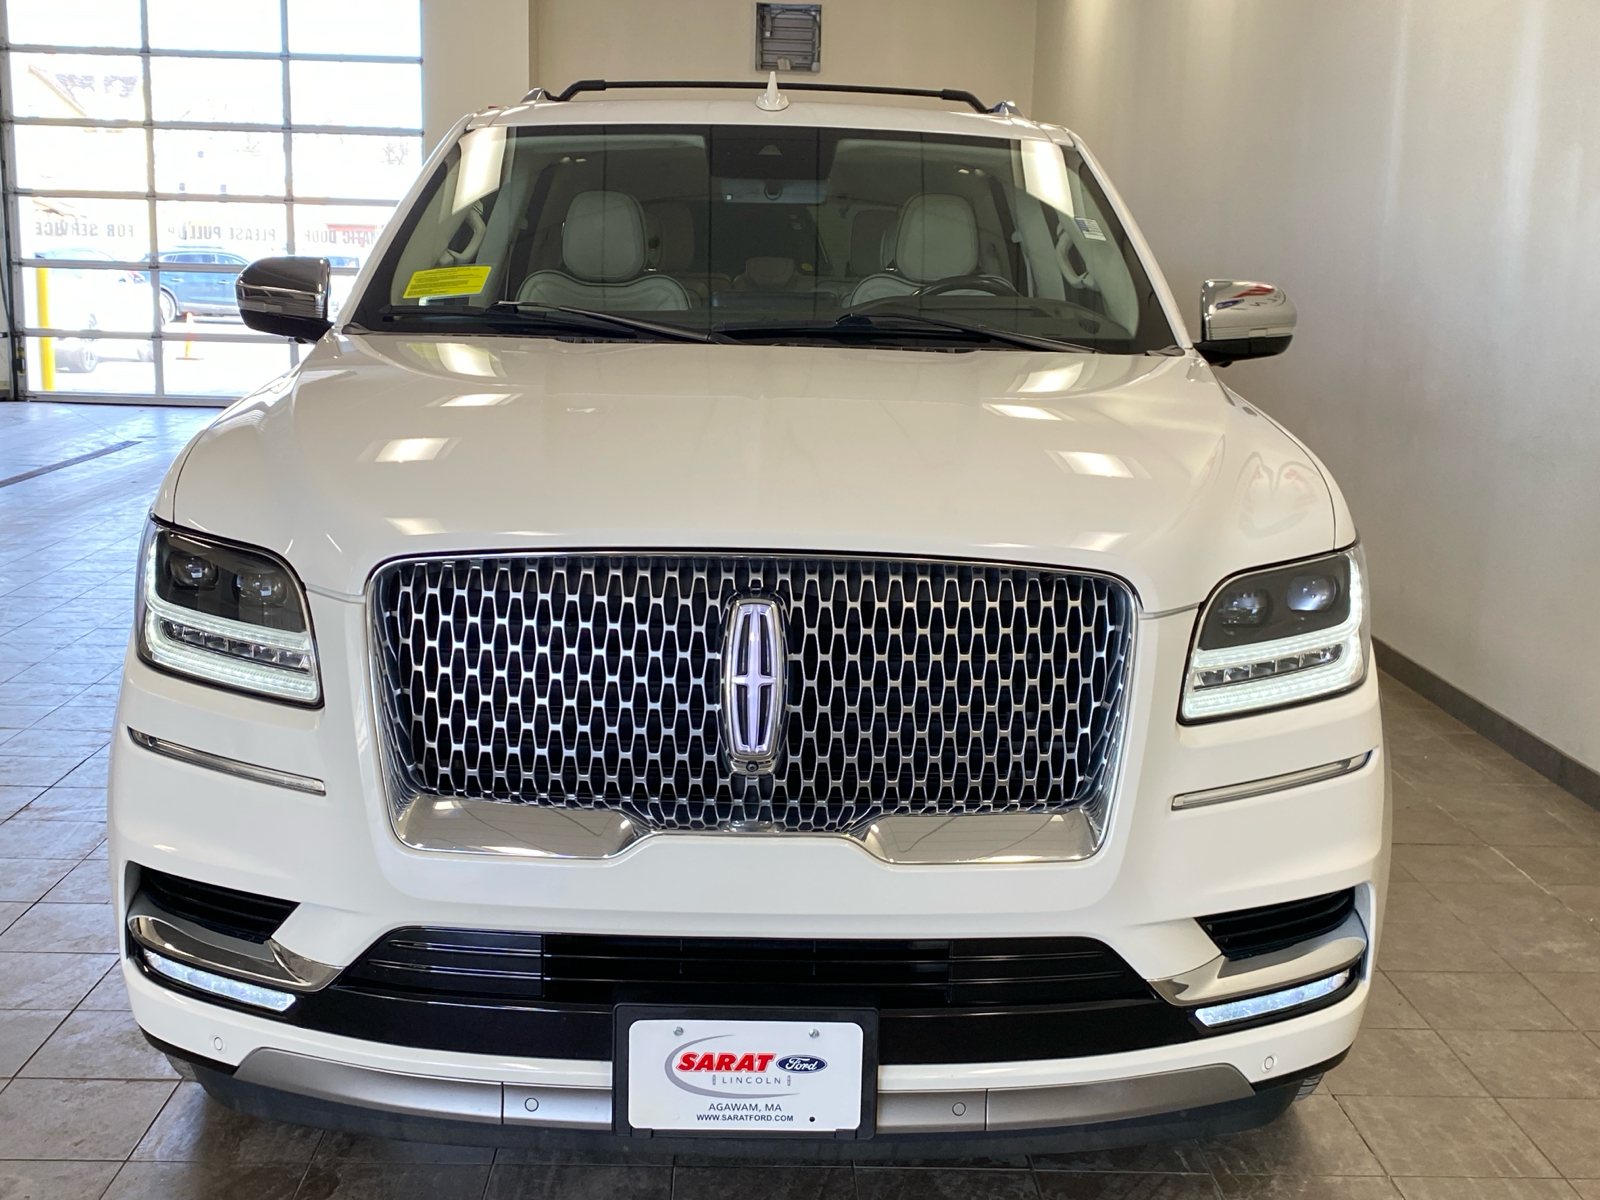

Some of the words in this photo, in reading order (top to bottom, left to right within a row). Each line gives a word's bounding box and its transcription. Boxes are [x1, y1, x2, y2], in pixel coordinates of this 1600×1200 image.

[676, 1052, 777, 1073] SARAT
[785, 1057, 818, 1071] Ford
[722, 1076, 781, 1085] LINCOLN
[708, 1103, 762, 1113] AGAWAM,
[765, 1103, 782, 1112] MA
[696, 1114, 794, 1122] WWW.SARATFORD.COM
